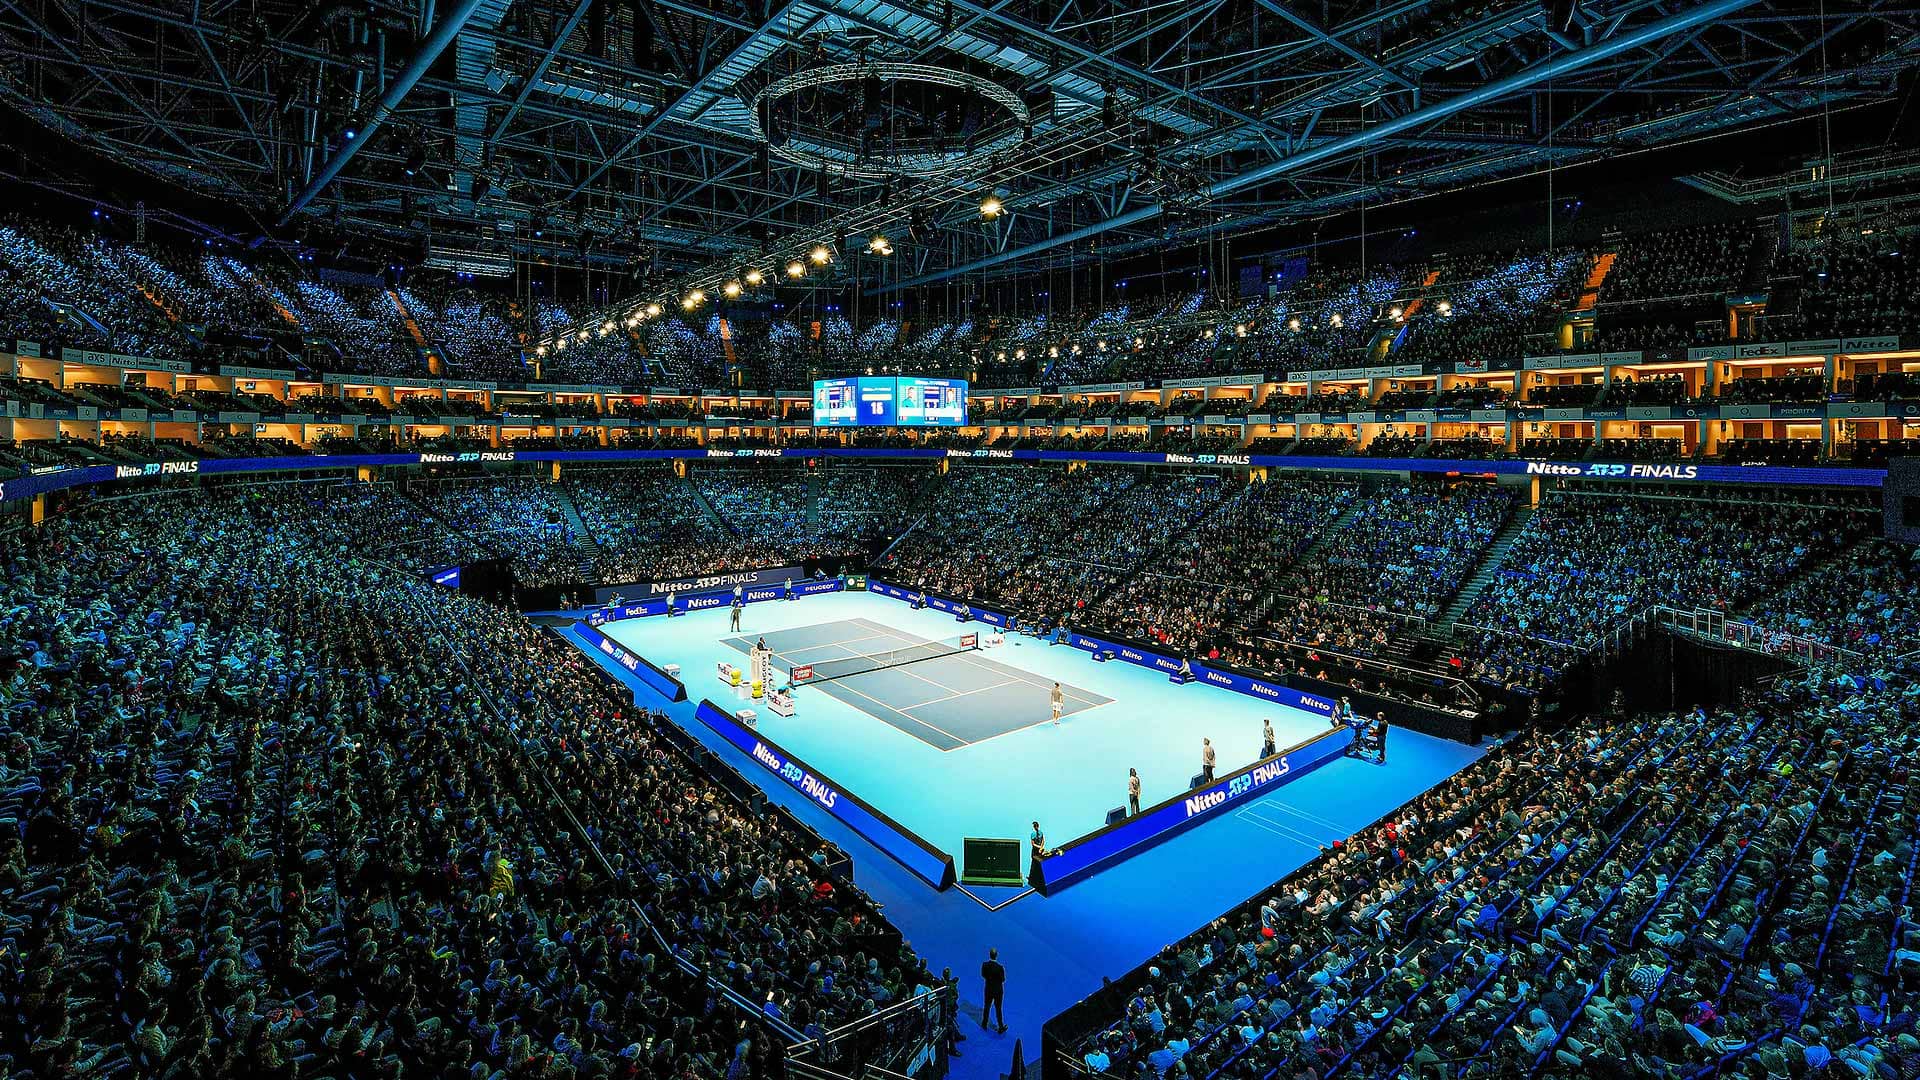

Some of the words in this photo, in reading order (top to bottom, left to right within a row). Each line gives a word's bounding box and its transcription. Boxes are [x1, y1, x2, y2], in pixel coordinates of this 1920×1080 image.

[1740, 346, 1778, 356] FedEx
[1845, 340, 1897, 350] Nitto
[87, 352, 105, 362] axs
[111, 357, 136, 366] Nitto
[420, 453, 455, 463] Nitto
[457, 452, 480, 461] ATP
[480, 451, 515, 461] FINALS
[707, 449, 734, 457] Nitto
[735, 449, 753, 457] ATP
[754, 449, 782, 457] FINALS
[946, 449, 972, 457] Nitto
[972, 449, 988, 457] ATP
[988, 449, 1013, 458] FINALS
[1165, 453, 1194, 463] Nitto
[1195, 454, 1216, 463] ATP
[1217, 455, 1250, 465] FINALS
[116, 464, 142, 478] Nitto
[143, 463, 160, 475] ATP
[161, 461, 198, 474] FINALS
[1527, 462, 1581, 475] Nitto
[1584, 463, 1625, 475] ATP
[1630, 464, 1697, 479] FINALS
[650, 582, 692, 594] Nitto
[693, 576, 720, 588] ATP
[720, 572, 758, 585] FINALS
[805, 583, 835, 592] PEUGEOT
[747, 591, 776, 600] Nitto
[687, 598, 720, 608] Nitto
[625, 606, 648, 616] FedEx
[1079, 638, 1098, 649] Nitto
[1121, 649, 1143, 661] Nitto
[621, 652, 639, 671] FINALS
[1156, 658, 1178, 670] Nitto
[1207, 671, 1233, 685] Nitto
[1251, 683, 1279, 697] Nitto
[1300, 696, 1331, 711] Nitto
[752, 741, 781, 770] Nitto
[780, 761, 803, 782] ATP
[800, 773, 838, 808] FINALS
[1185, 790, 1226, 817] Nitto
[1227, 773, 1252, 798] ATP
[1252, 756, 1290, 786] FINALS
